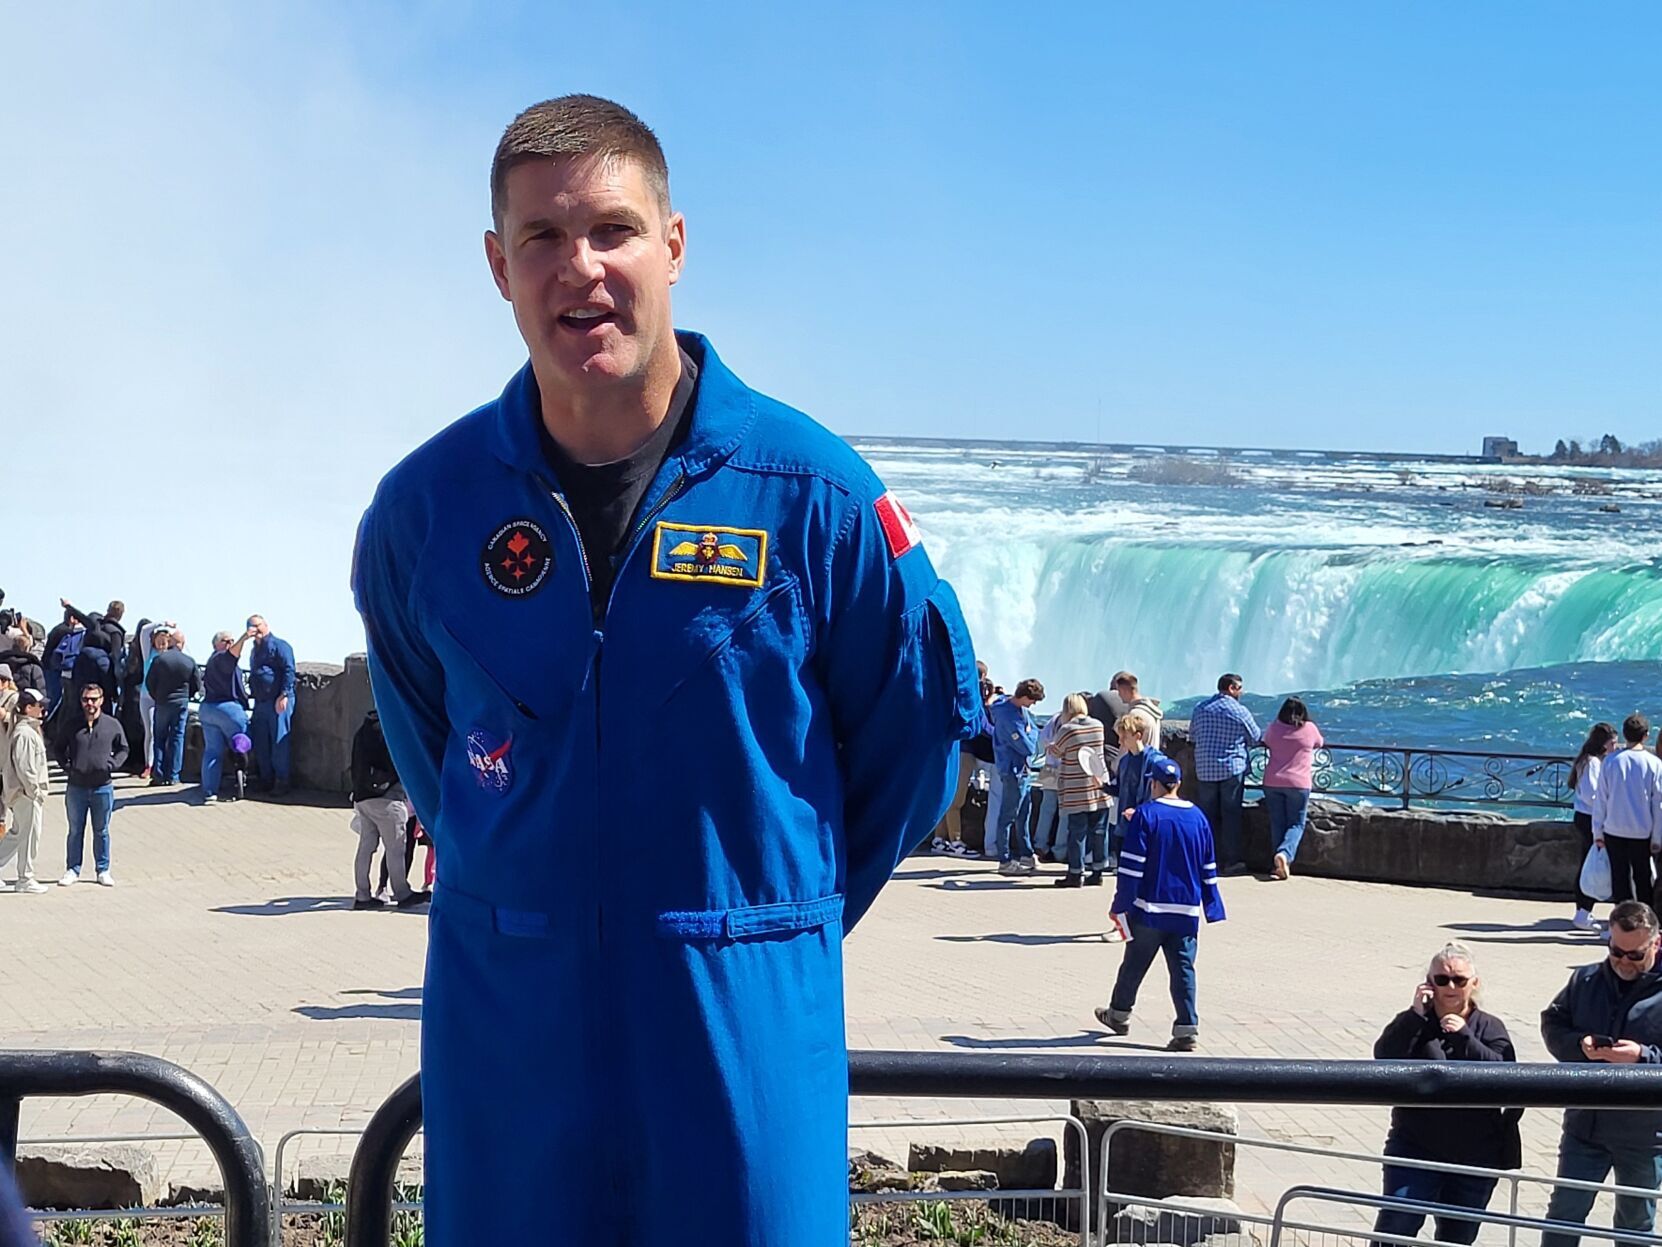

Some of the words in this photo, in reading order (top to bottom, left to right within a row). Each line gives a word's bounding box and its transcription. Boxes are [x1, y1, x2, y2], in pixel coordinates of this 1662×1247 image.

[671, 562, 704, 574] JEREMY
[708, 564, 744, 577] HANSEN
[467, 749, 509, 774] NASA
